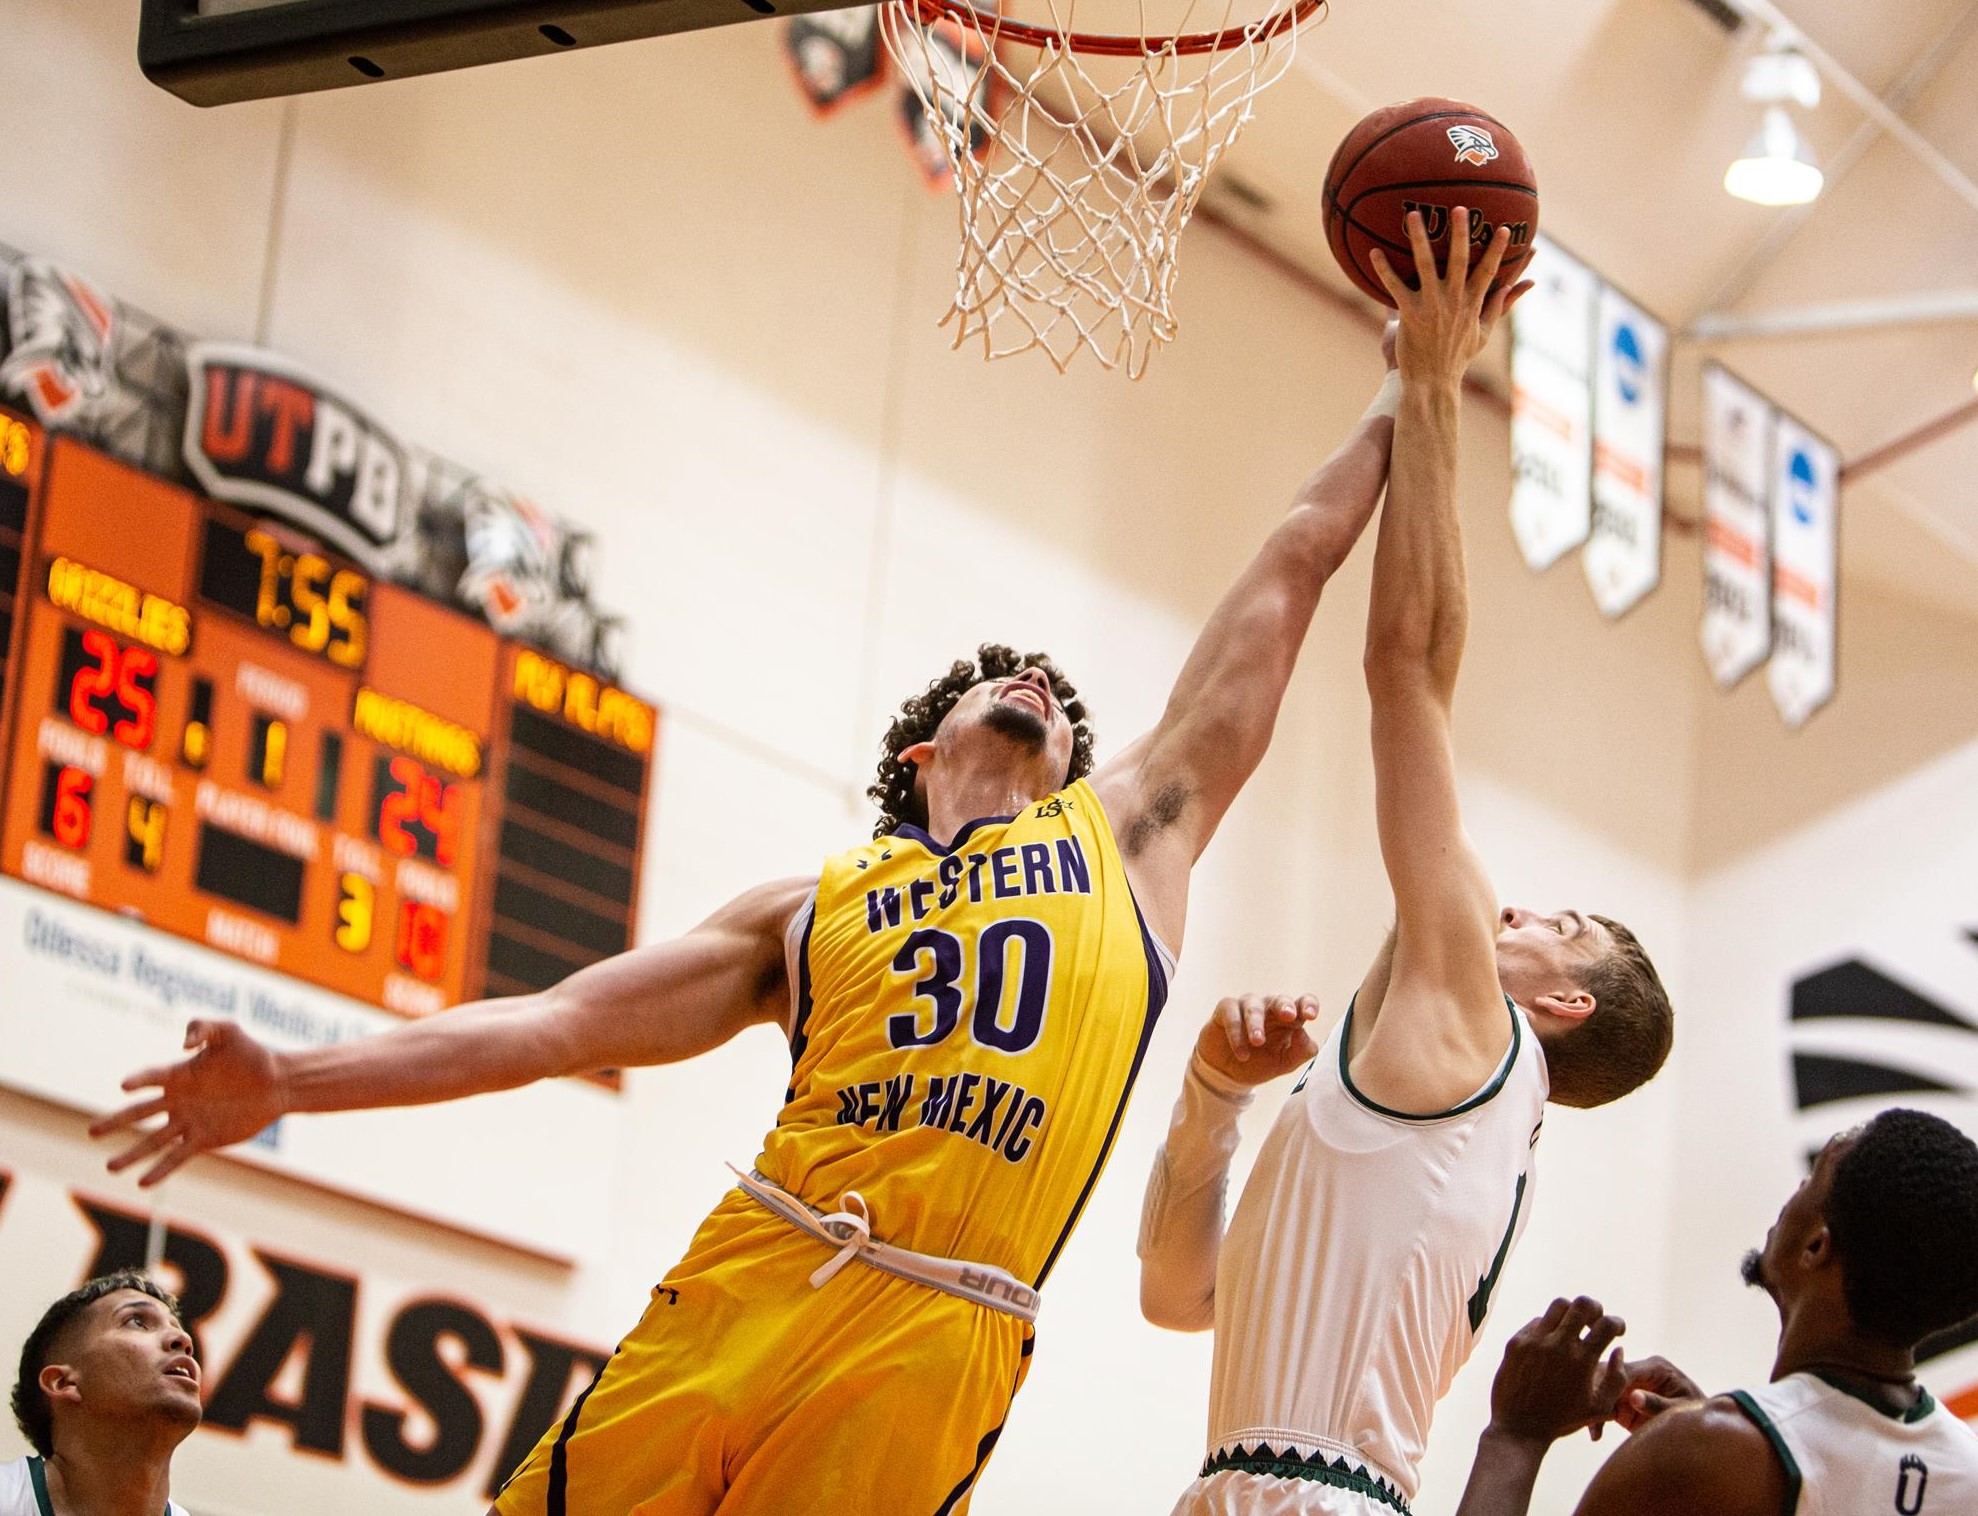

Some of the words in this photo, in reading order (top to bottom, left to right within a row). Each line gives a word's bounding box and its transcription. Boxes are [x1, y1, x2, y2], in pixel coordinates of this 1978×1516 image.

[1402, 200, 1529, 248] Wlsn
[203, 364, 401, 541] UTPB
[70, 629, 157, 749] 25
[53, 764, 93, 849] 6
[128, 794, 168, 871] 4
[378, 756, 463, 867] 24
[336, 872, 374, 951] 3
[865, 833, 1092, 934] WESTERN
[887, 918, 1054, 1057] 30
[836, 1073, 915, 1133] NEW
[918, 1072, 1047, 1165] MEXIC
[957, 1266, 1041, 1312] OUR
